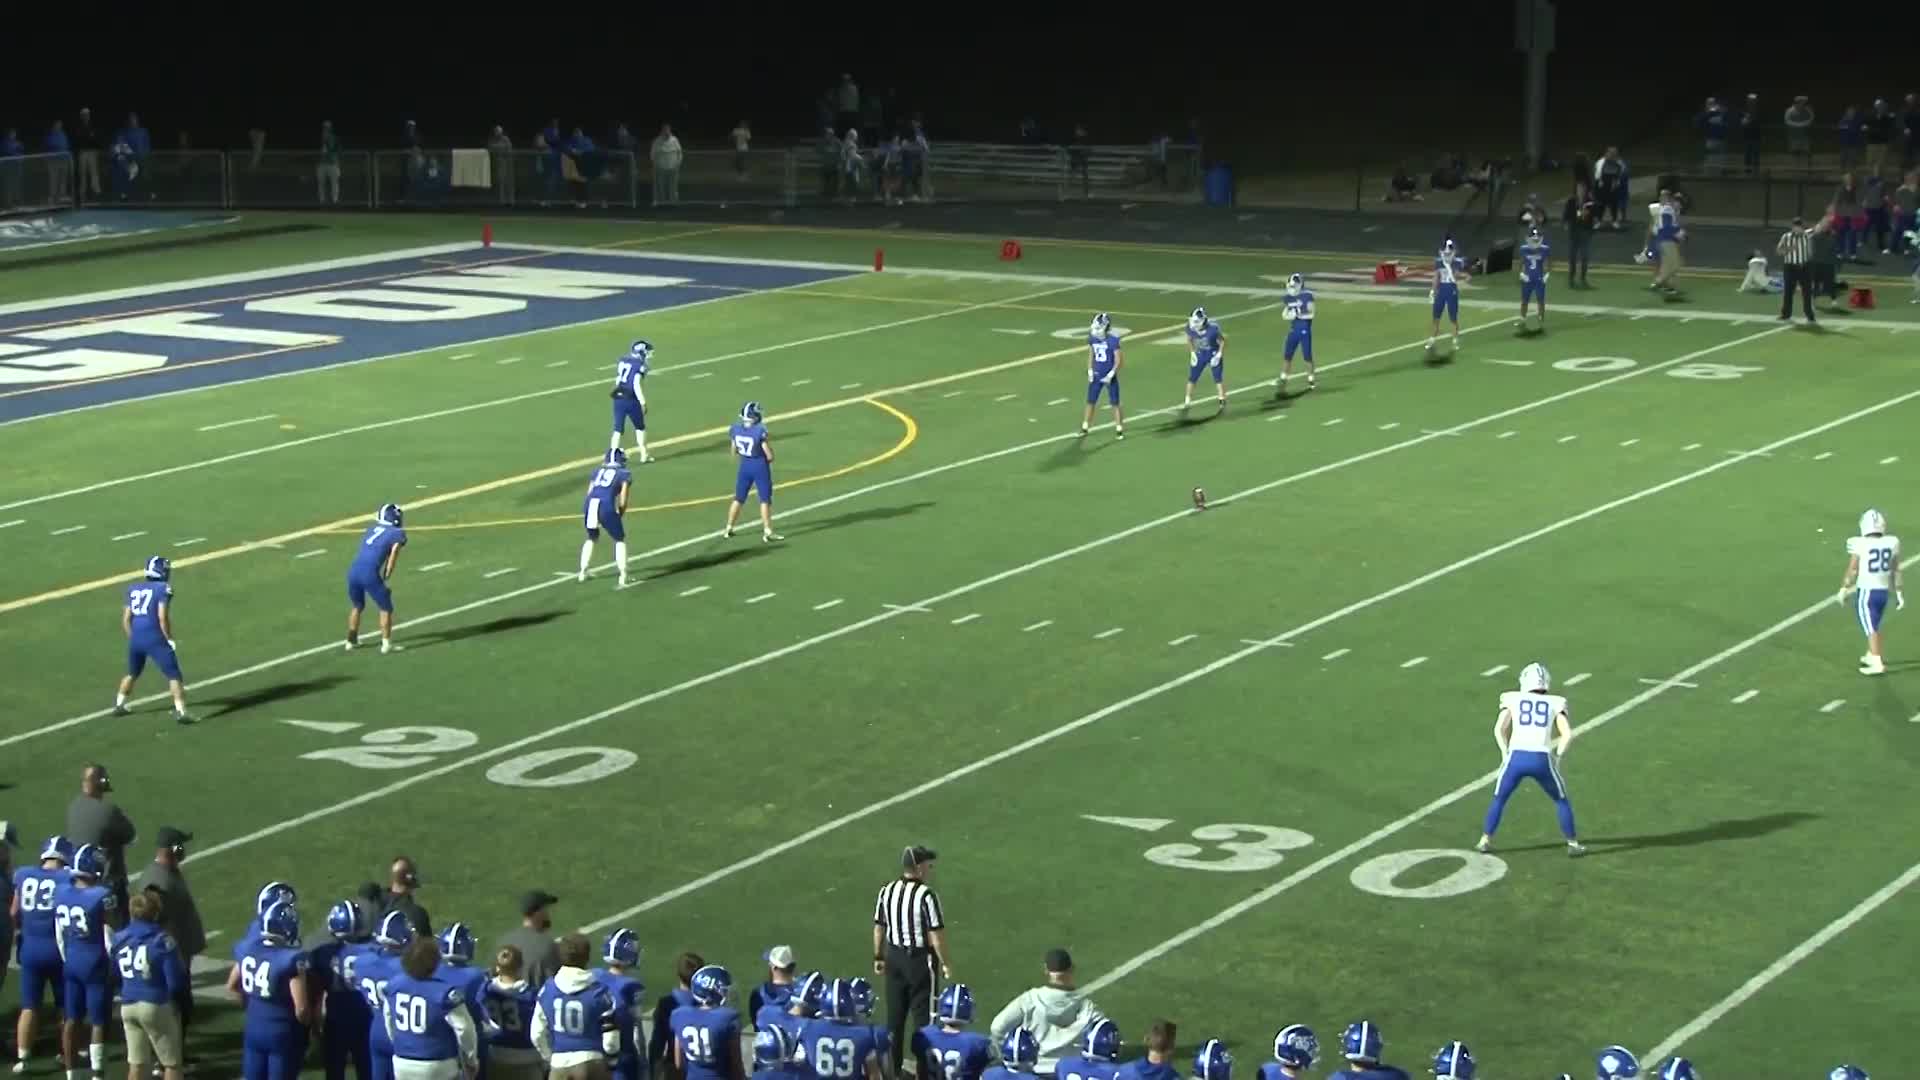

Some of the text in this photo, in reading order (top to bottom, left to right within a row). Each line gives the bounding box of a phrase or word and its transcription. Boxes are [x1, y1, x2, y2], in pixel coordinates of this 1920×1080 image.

[735, 435, 755, 457] 57
[365, 526, 386, 546] 7
[1867, 547, 1893, 574] 28
[130, 588, 153, 616] 27
[1519, 699, 1549, 728] 89
[20, 876, 57, 912] 83
[117, 945, 151, 980] 24
[241, 955, 271, 997] 64
[395, 991, 427, 1034] 50
[553, 997, 585, 1035] 10
[681, 1025, 716, 1062] 31
[815, 1036, 856, 1078] 63
